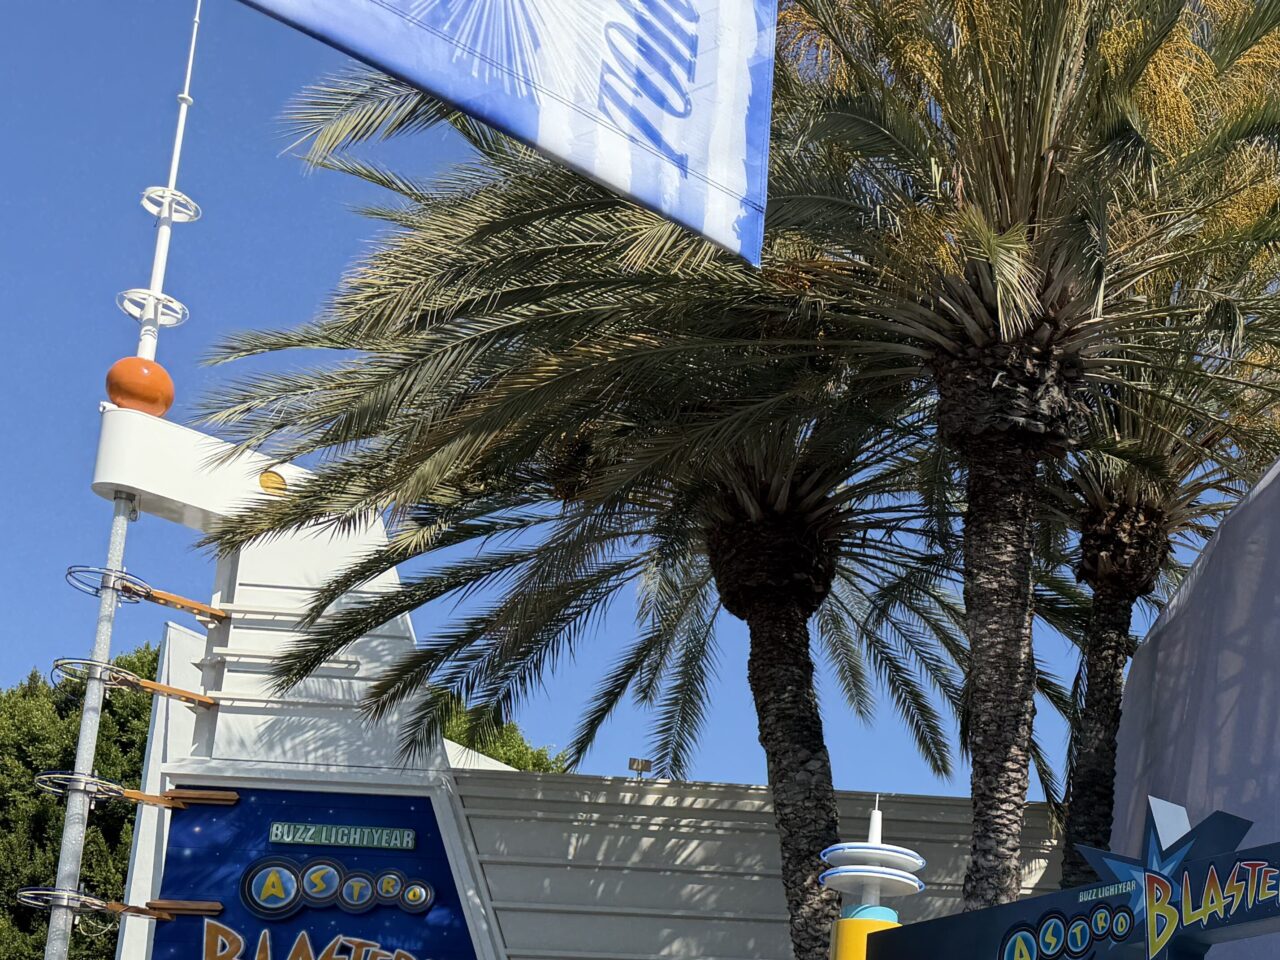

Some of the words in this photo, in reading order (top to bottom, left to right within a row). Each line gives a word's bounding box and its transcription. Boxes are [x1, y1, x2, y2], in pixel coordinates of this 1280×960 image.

[270, 821, 315, 843] BUZZ
[320, 824, 416, 849] LIGHTYEAR
[251, 865, 426, 908] ASTRO
[1079, 889, 1098, 902] BUZZ
[1098, 879, 1137, 899] LIGHTYEAR
